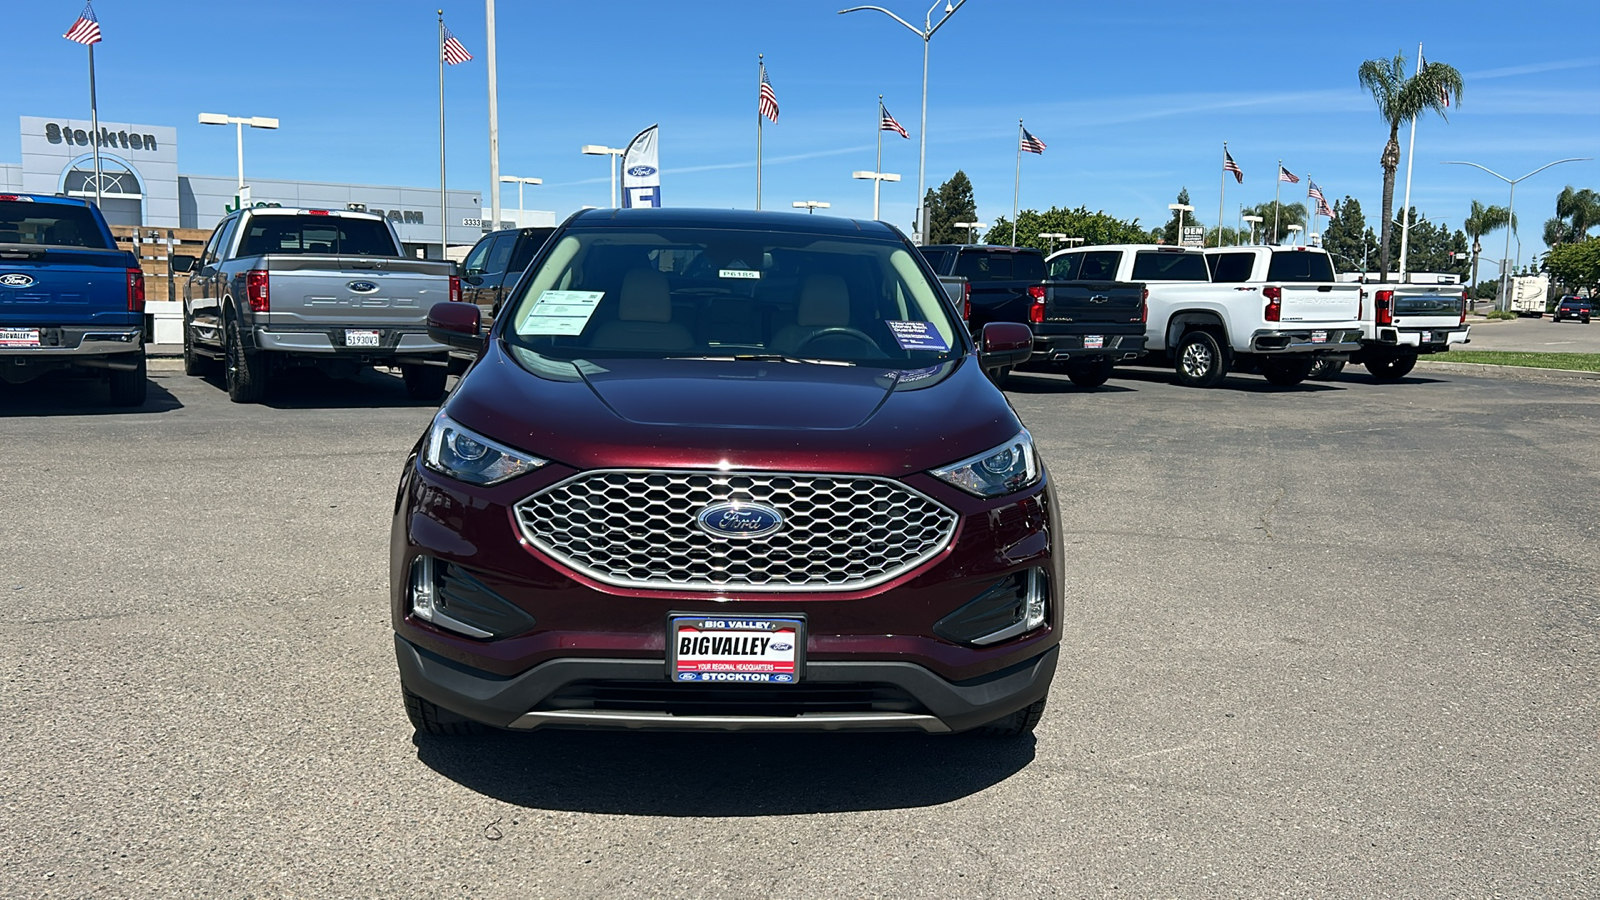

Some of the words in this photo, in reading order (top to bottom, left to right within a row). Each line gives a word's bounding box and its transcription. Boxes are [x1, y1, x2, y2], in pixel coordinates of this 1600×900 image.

[45, 123, 157, 151] Stockton
[463, 218, 481, 226] 3333
[1184, 227, 1203, 235] OEM
[303, 295, 420, 309] F-150
[1288, 297, 1356, 305] CHEVROLET
[719, 510, 762, 529] Ford
[704, 621, 726, 629] BIG
[728, 621, 771, 630] VALLEY
[679, 636, 771, 656] BIGVALLEY
[712, 663, 735, 671] REGIONAL
[702, 673, 770, 682] STOCKTON
